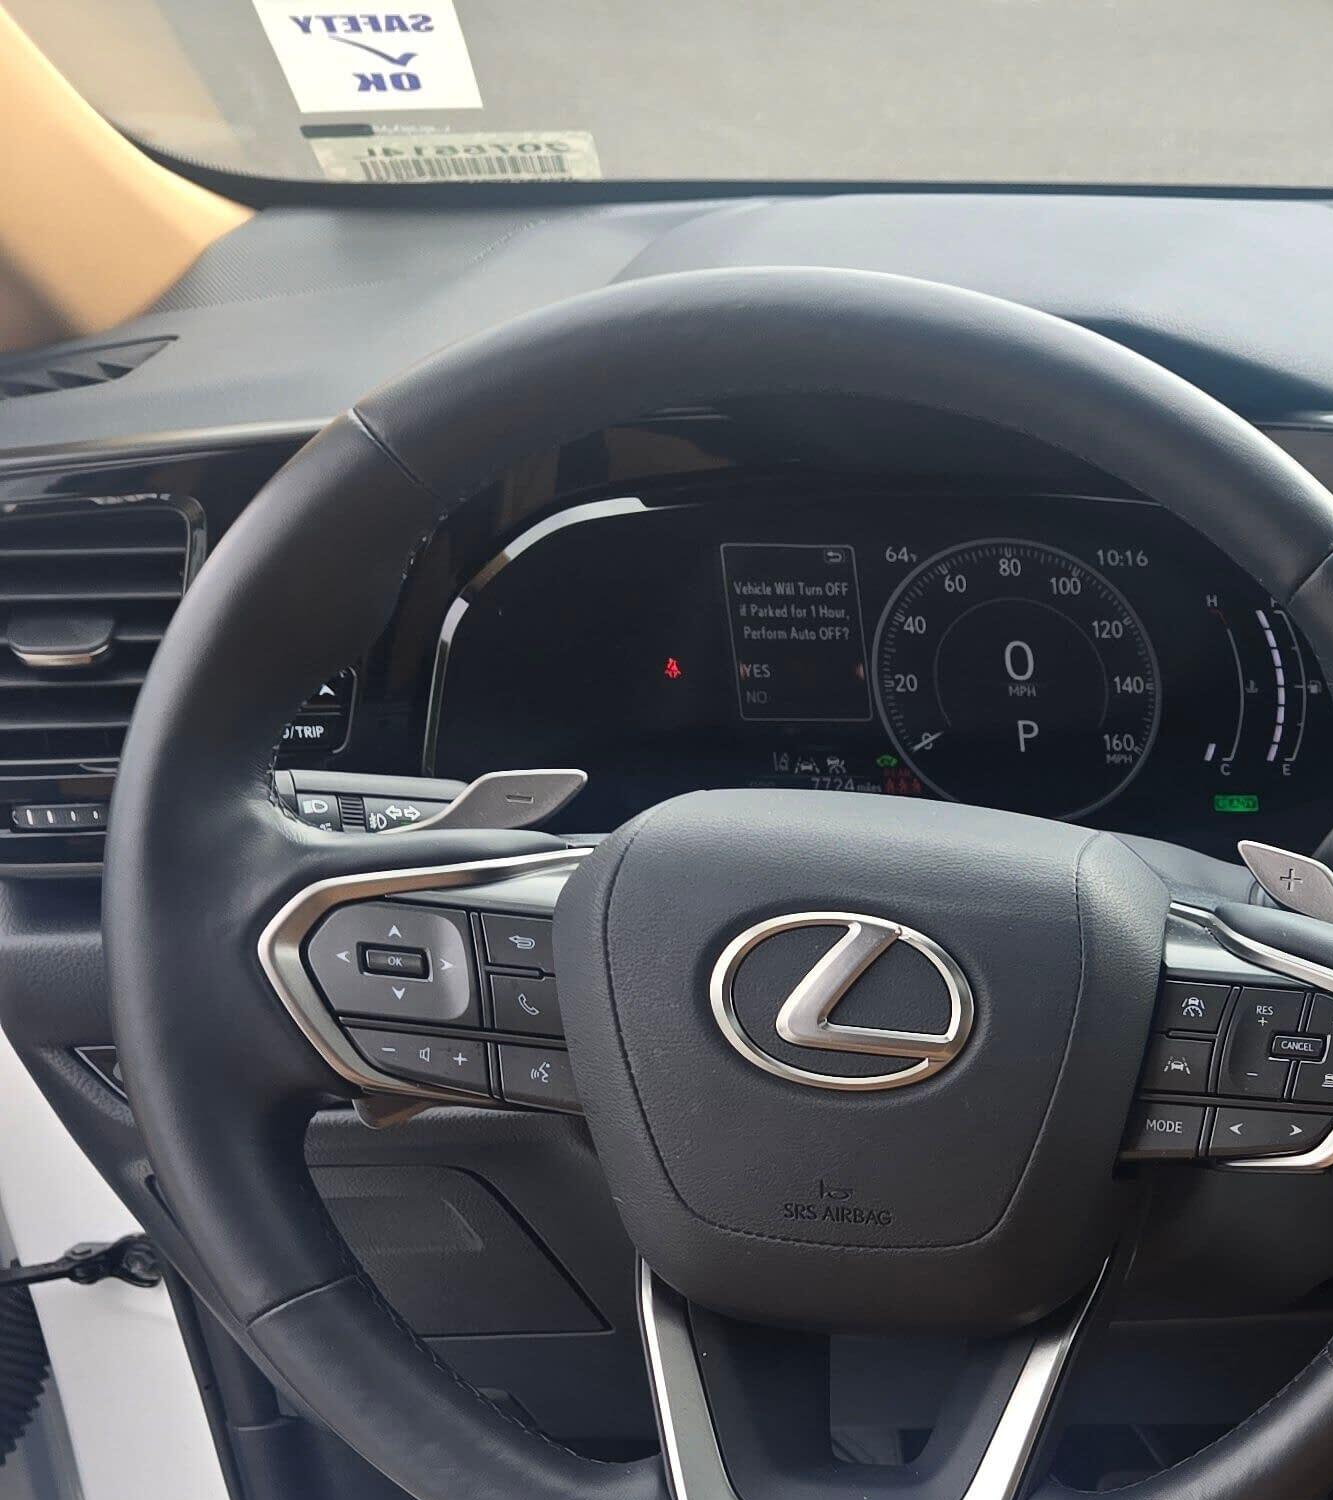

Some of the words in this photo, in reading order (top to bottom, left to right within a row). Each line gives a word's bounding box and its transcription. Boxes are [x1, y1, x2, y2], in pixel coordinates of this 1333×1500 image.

[1096, 550, 1149, 567] 10:16
[999, 558, 1021, 576] 80
[733, 581, 772, 596] Vehicle
[774, 581, 795, 596] Will
[798, 582, 823, 596] Turn
[825, 582, 849, 597] OFF
[944, 575, 966, 593] 60
[1050, 577, 1081, 595] 100
[1206, 594, 1218, 607] H
[750, 604, 788, 618] Parked
[790, 604, 807, 618] for
[819, 605, 850, 620] Hour,
[903, 616, 926, 634] 40
[1092, 620, 1123, 638] 120
[743, 626, 787, 640] Perform
[790, 626, 817, 640] Auto
[819, 626, 850, 641] OFF?
[1005, 640, 1034, 681] 0
[744, 664, 771, 678] YES
[894, 674, 918, 692] 20
[1008, 685, 1037, 697] MPH
[1114, 676, 1144, 694] 140
[746, 690, 768, 704] NO
[1017, 720, 1039, 753] P
[1103, 734, 1134, 751] 160
[1106, 754, 1132, 764] MPH
[1220, 763, 1231, 776] C
[1282, 763, 1292, 776] E
[387, 957, 403, 967] OK
[1256, 1005, 1273, 1016] RES
[1281, 1040, 1314, 1052] CANCEL
[1146, 1119, 1183, 1134] MODE
[784, 1203, 818, 1221] SRS
[822, 1206, 893, 1226] AIRBAG
